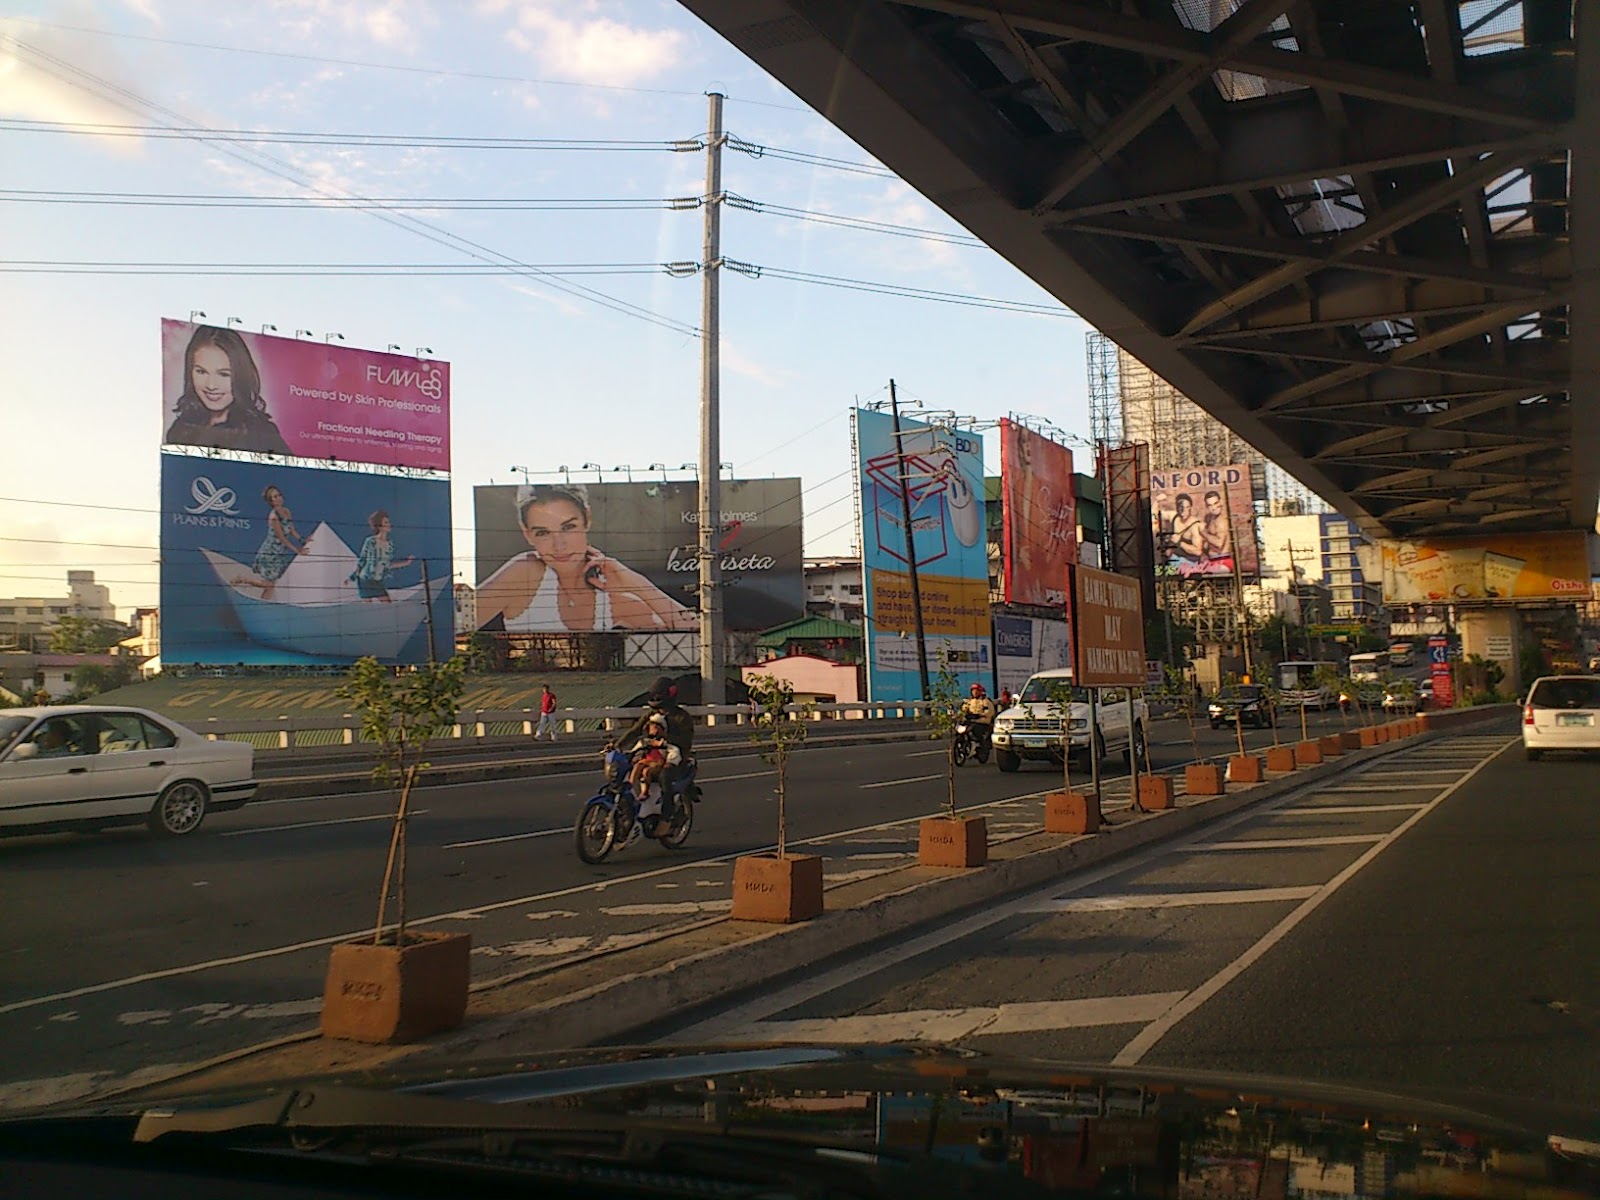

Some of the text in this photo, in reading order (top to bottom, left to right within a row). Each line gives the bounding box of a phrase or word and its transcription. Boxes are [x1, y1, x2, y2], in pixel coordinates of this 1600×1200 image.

[289, 384, 441, 414] Powered by Skin Professionals
[317, 421, 442, 444] Fractional Needling Therapy
[955, 438, 979, 455] BDO
[1151, 469, 1240, 490] NFORD
[173, 513, 208, 527] PLAINS
[218, 516, 251, 530] PRINTS
[719, 510, 758, 523] olmes
[667, 547, 776, 571] kaiseta
[1551, 579, 1585, 590] Oishi
[898, 589, 925, 600] abrd
[1104, 614, 1121, 641] MAY
